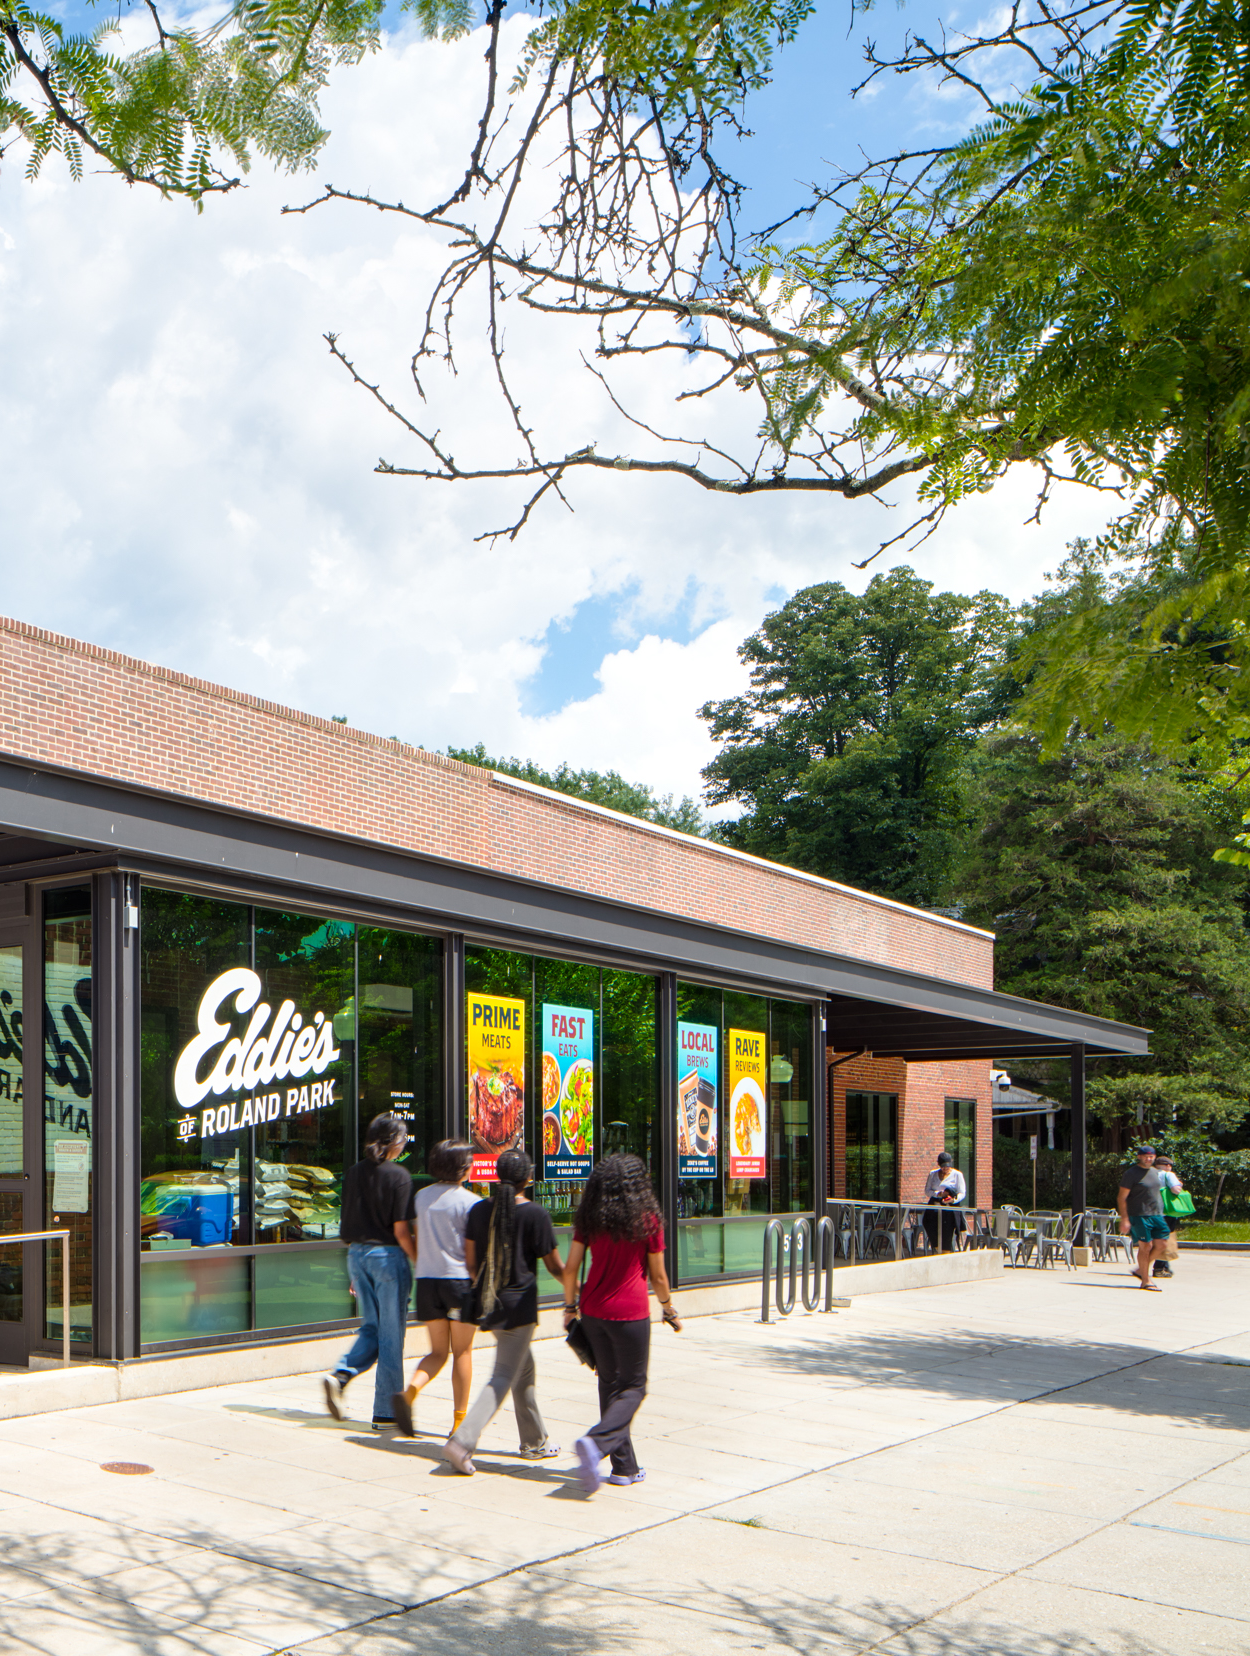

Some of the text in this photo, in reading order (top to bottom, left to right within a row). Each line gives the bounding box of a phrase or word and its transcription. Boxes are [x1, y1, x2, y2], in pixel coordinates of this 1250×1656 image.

[472, 1003, 521, 1031] PRIME
[551, 1013, 586, 1040] FAST
[174, 967, 341, 1109] Eddie's
[481, 1033, 512, 1049] MEATS
[681, 1030, 715, 1053] LOCAL
[735, 1037, 761, 1058] RAVE
[558, 1043, 578, 1058] EATS
[686, 1054, 710, 1069] BREWS
[735, 1060, 761, 1074] REVIEWS
[179, 1078, 336, 1139] OF ROLAND PARK
